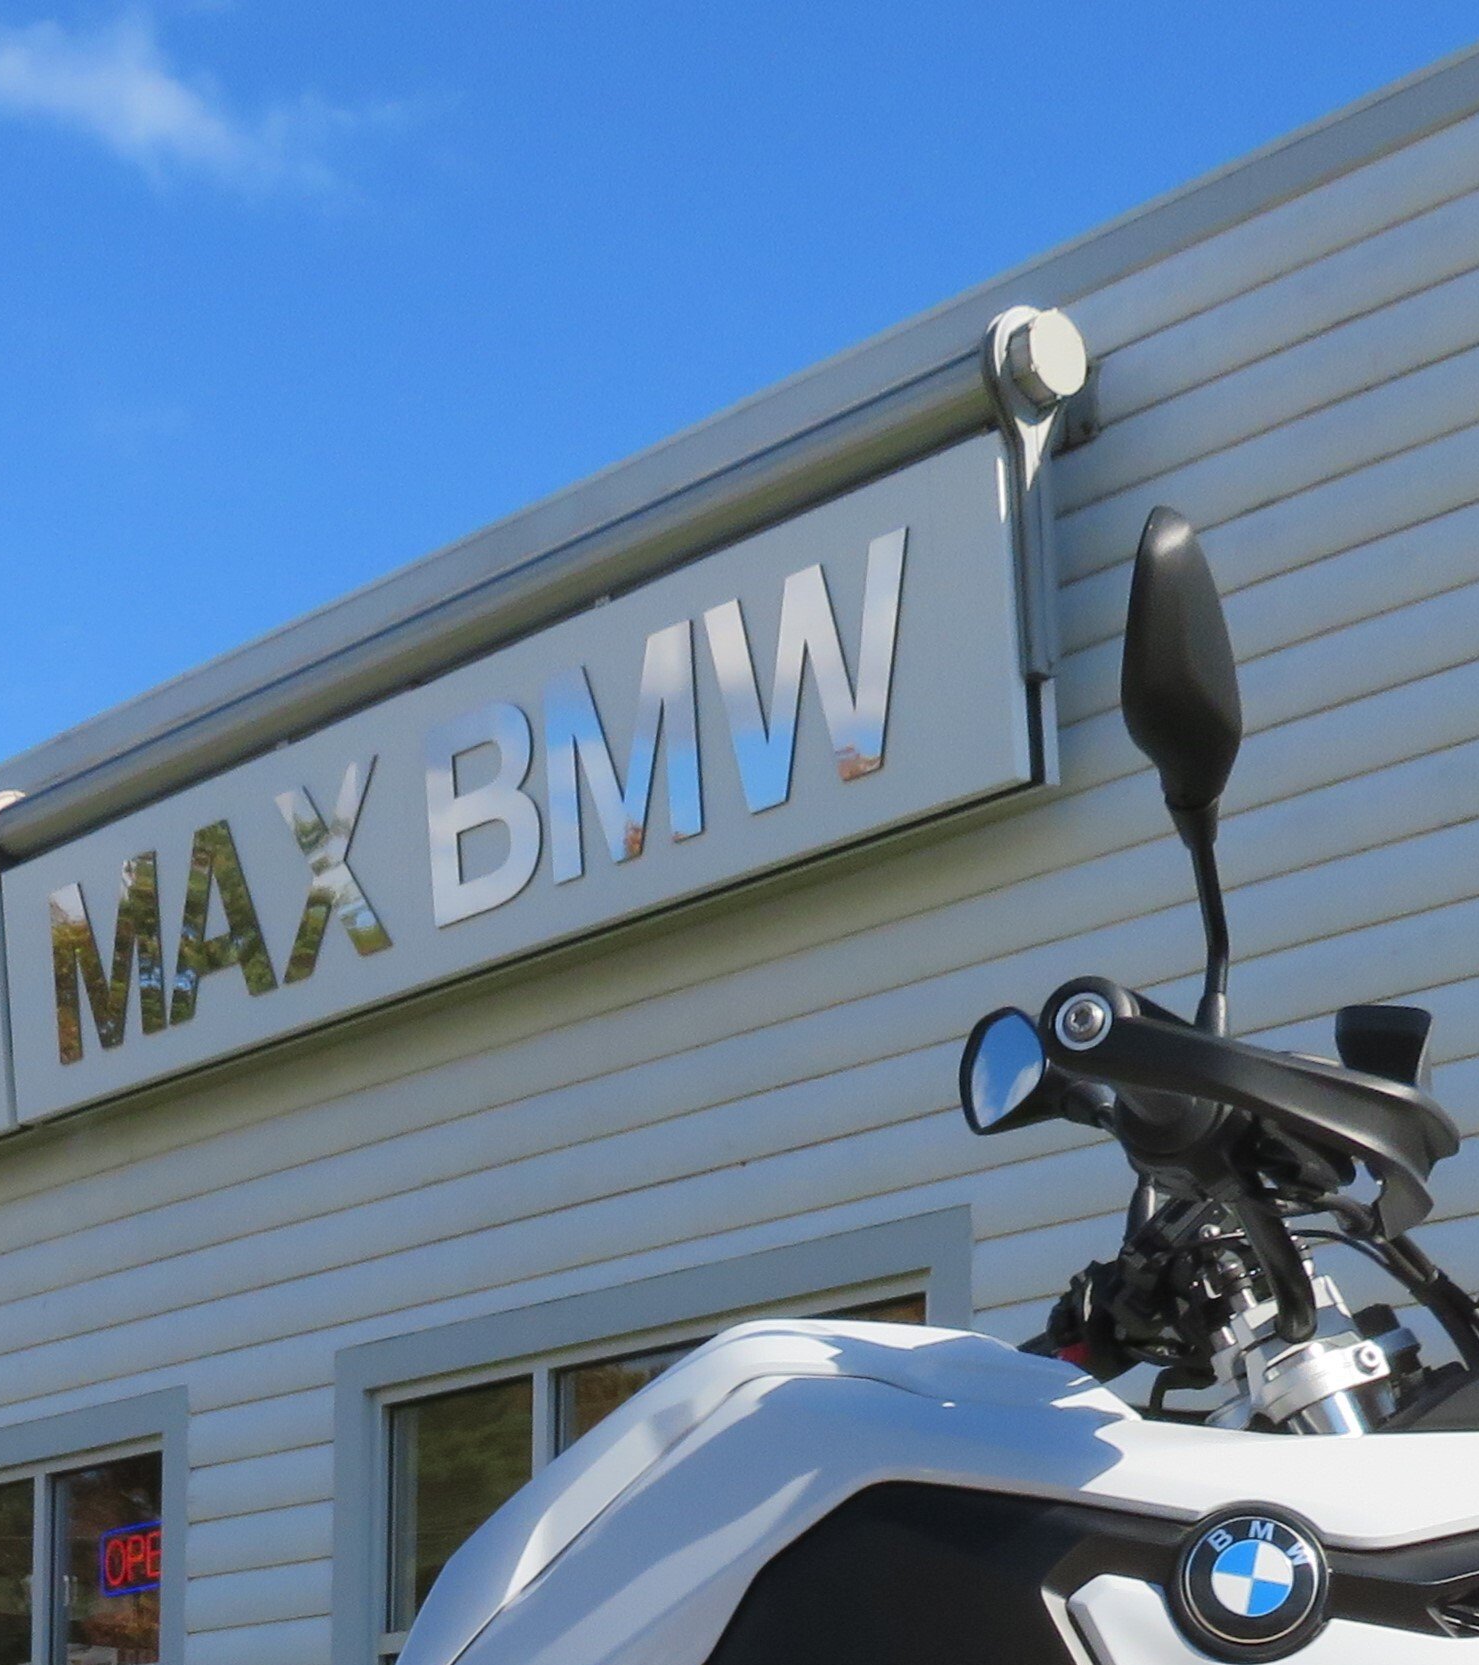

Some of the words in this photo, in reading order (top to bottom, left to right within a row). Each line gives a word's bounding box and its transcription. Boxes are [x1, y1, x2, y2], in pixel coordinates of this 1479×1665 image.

[48, 753, 393, 1065] MAX
[424, 525, 909, 929] BMW
[104, 1529, 162, 1587] OPE
[1207, 1519, 1314, 1567] BMW
